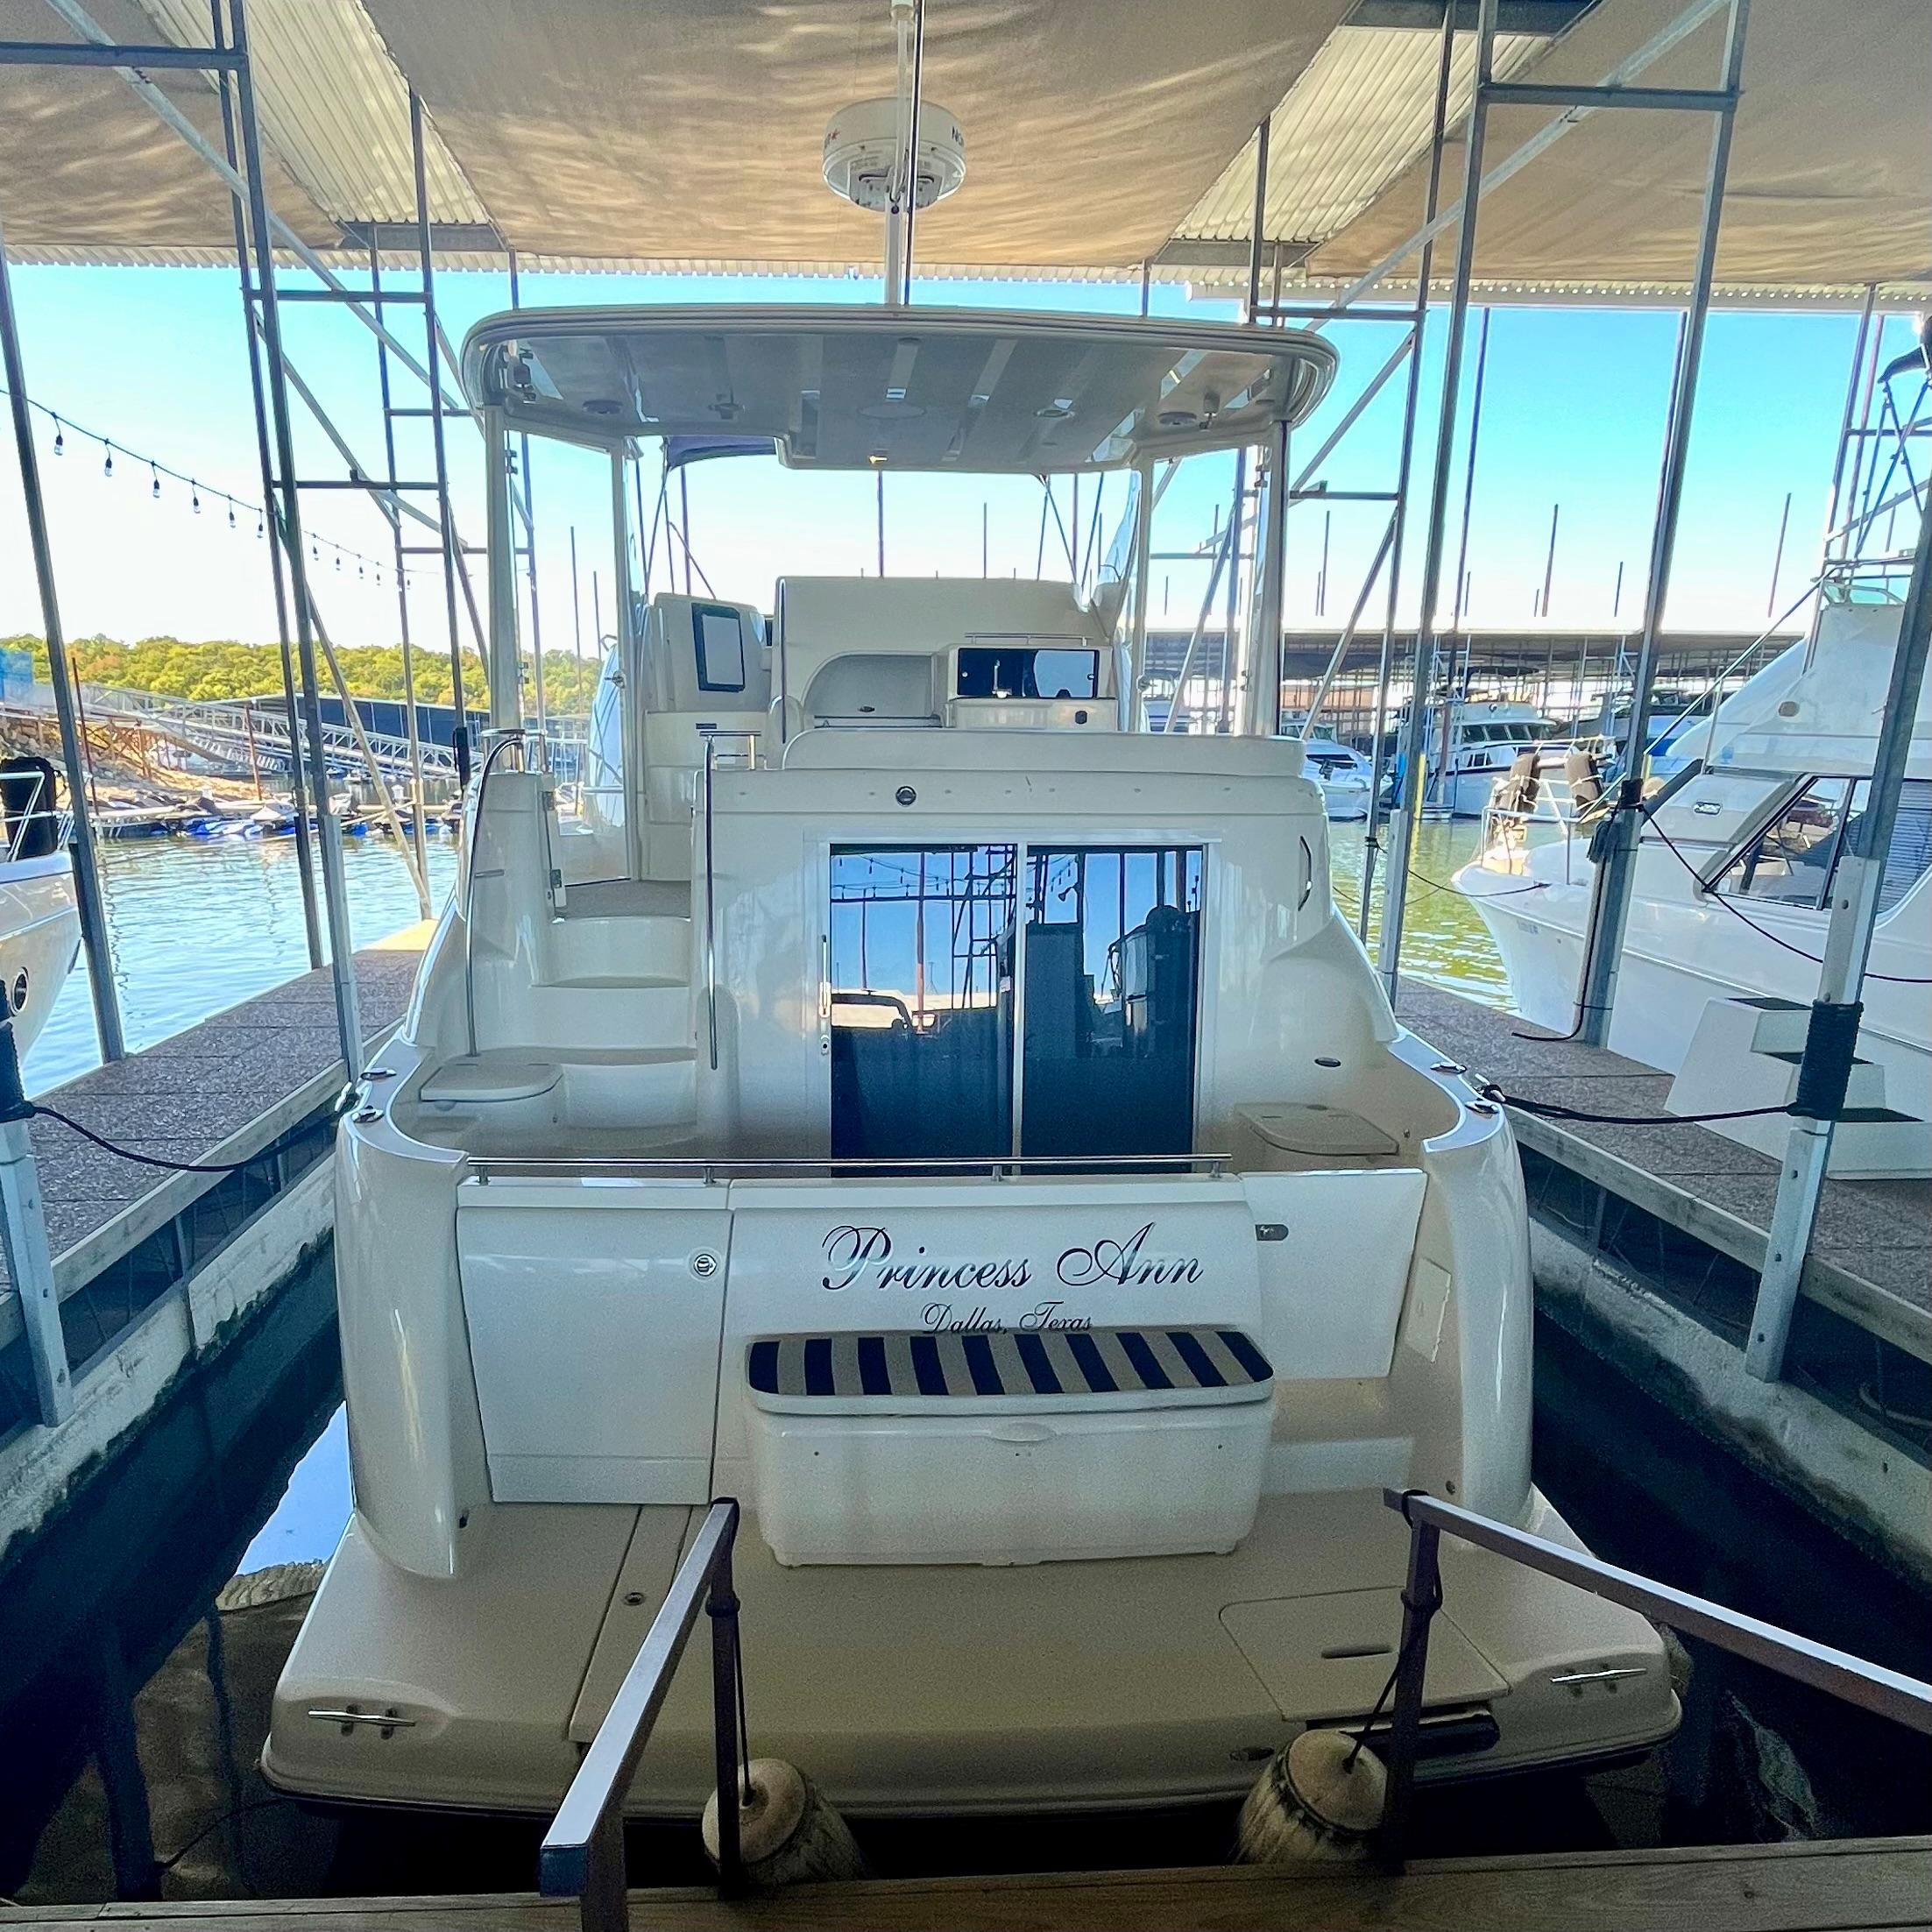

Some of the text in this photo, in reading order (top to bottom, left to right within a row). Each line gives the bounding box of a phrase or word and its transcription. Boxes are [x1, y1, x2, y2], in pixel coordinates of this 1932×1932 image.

[822, 1221, 1204, 1290] Princess Ann
[920, 1301, 1092, 1334] Dallas, Texas
